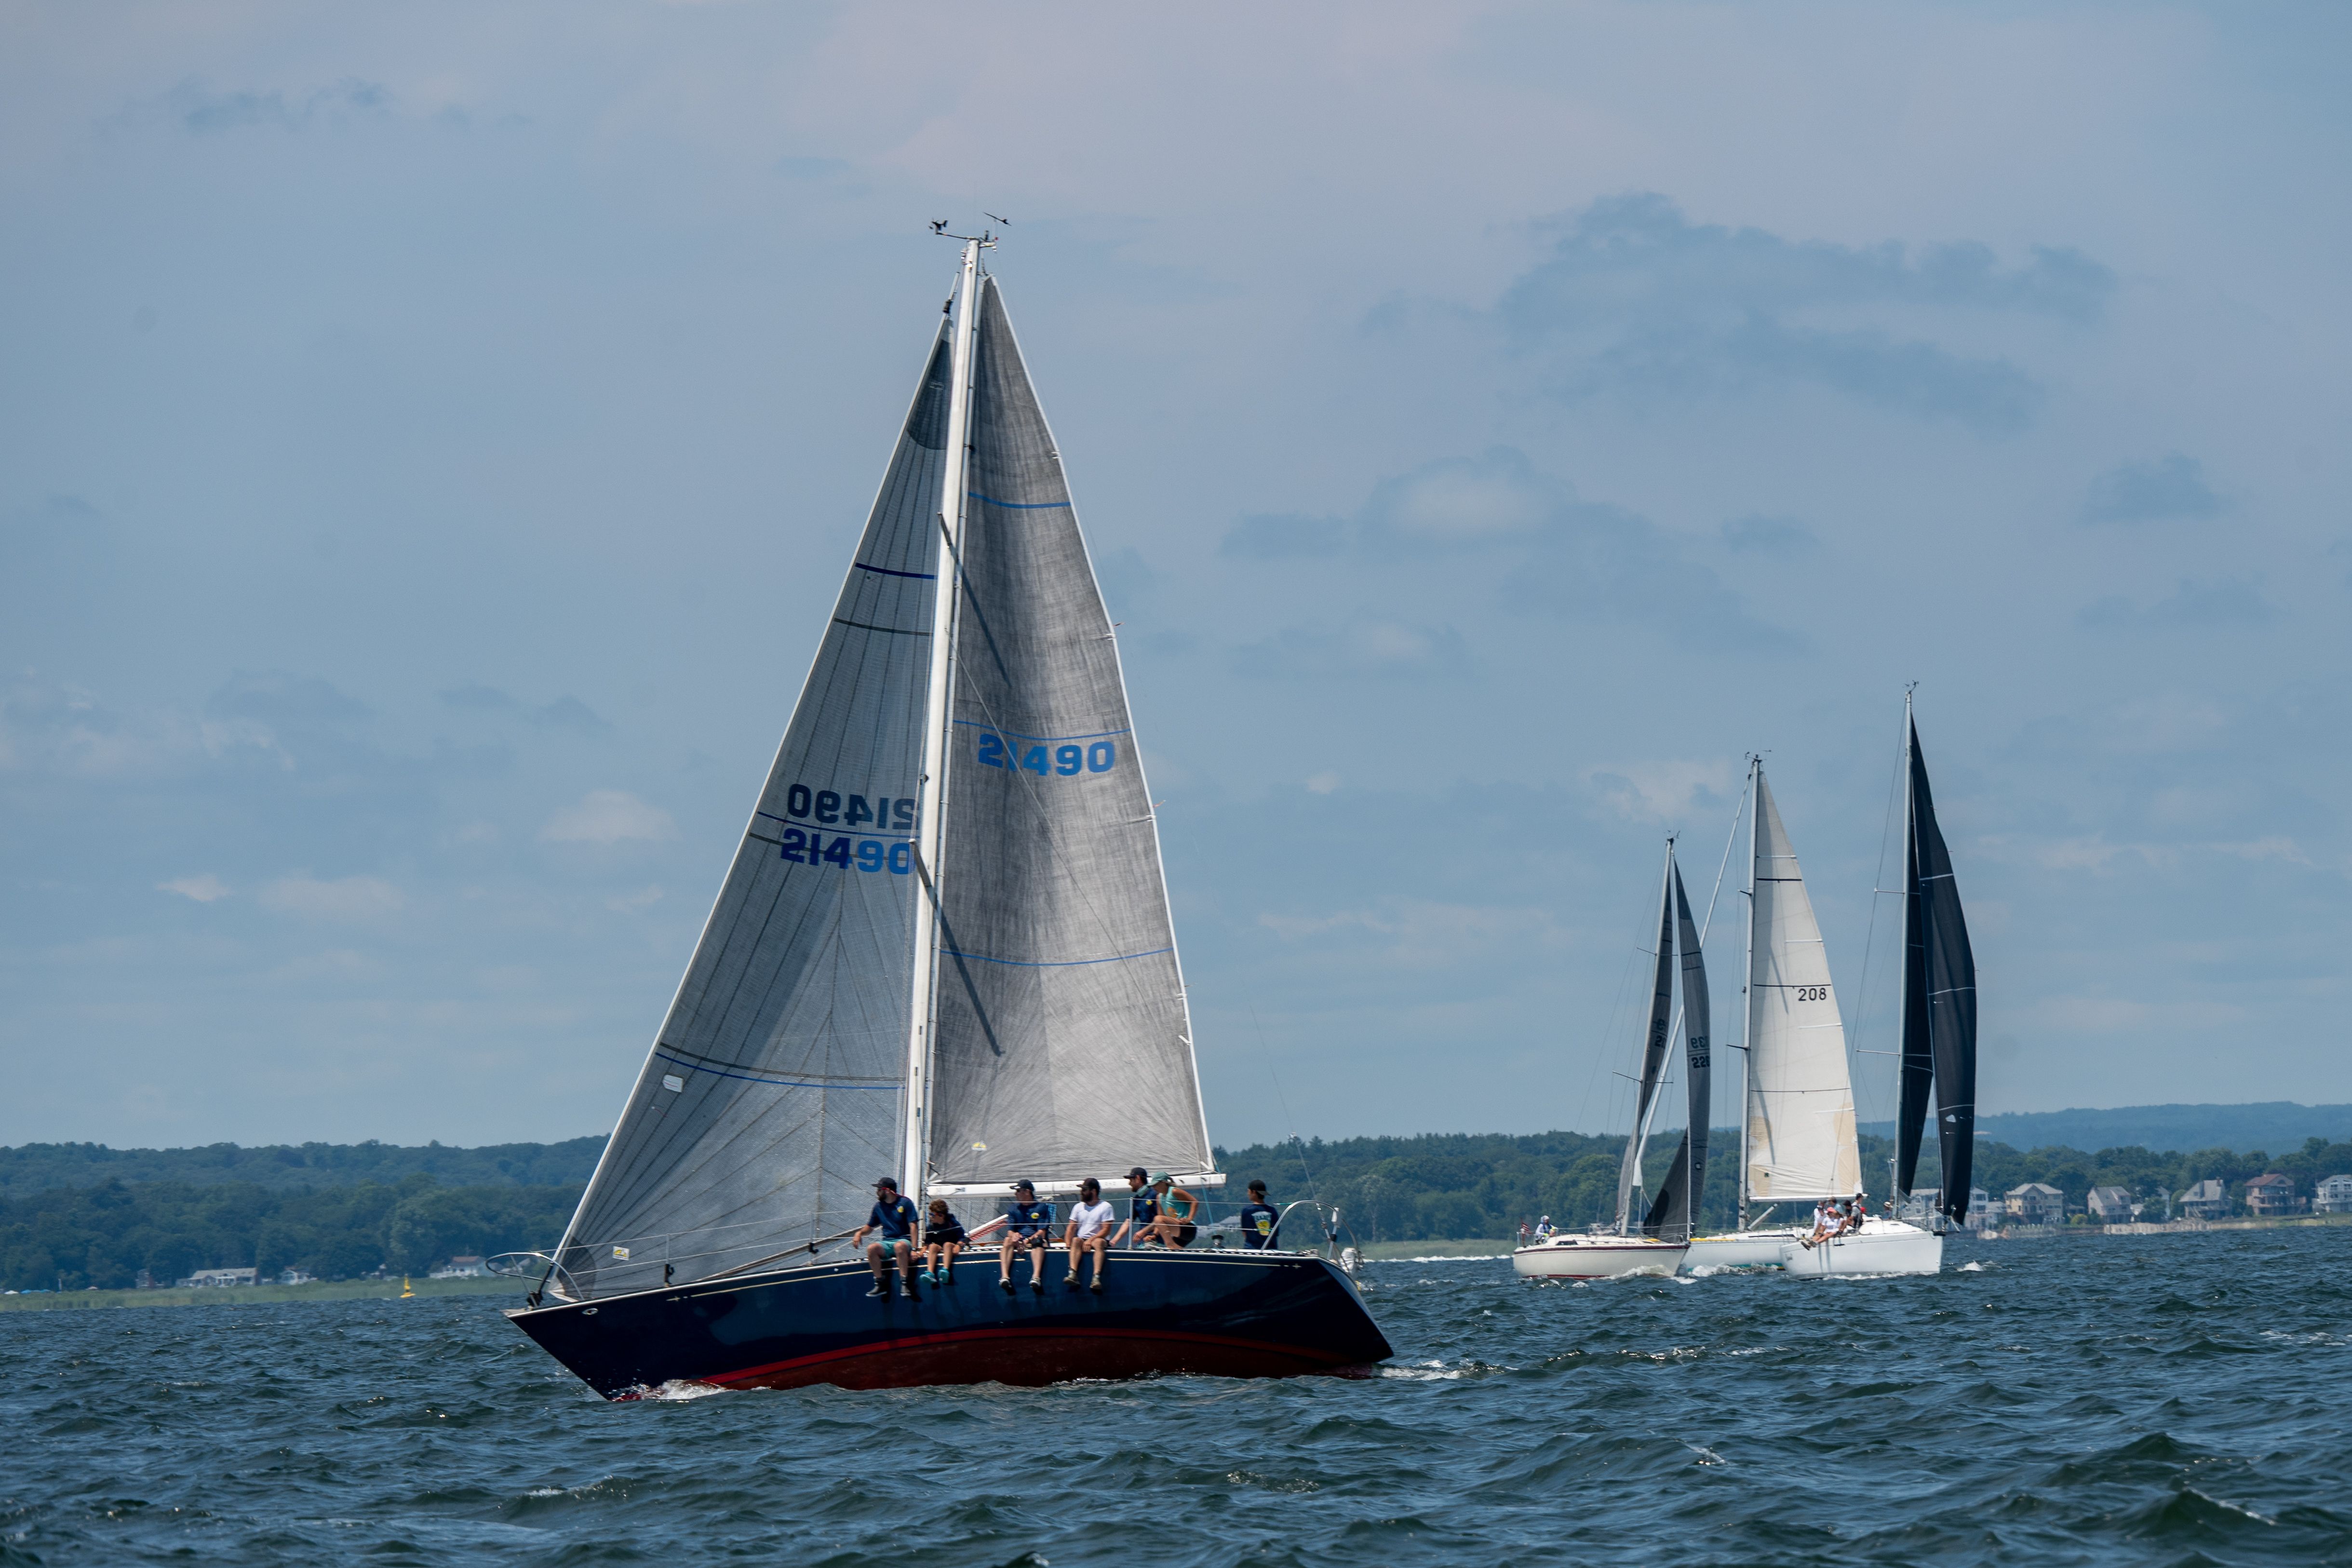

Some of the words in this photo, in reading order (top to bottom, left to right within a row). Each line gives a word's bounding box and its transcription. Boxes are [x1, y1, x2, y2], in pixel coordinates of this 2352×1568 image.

[978, 733, 1116, 776] 21490
[781, 828, 917, 875] 21490
[1798, 988, 1827, 1001] 208
